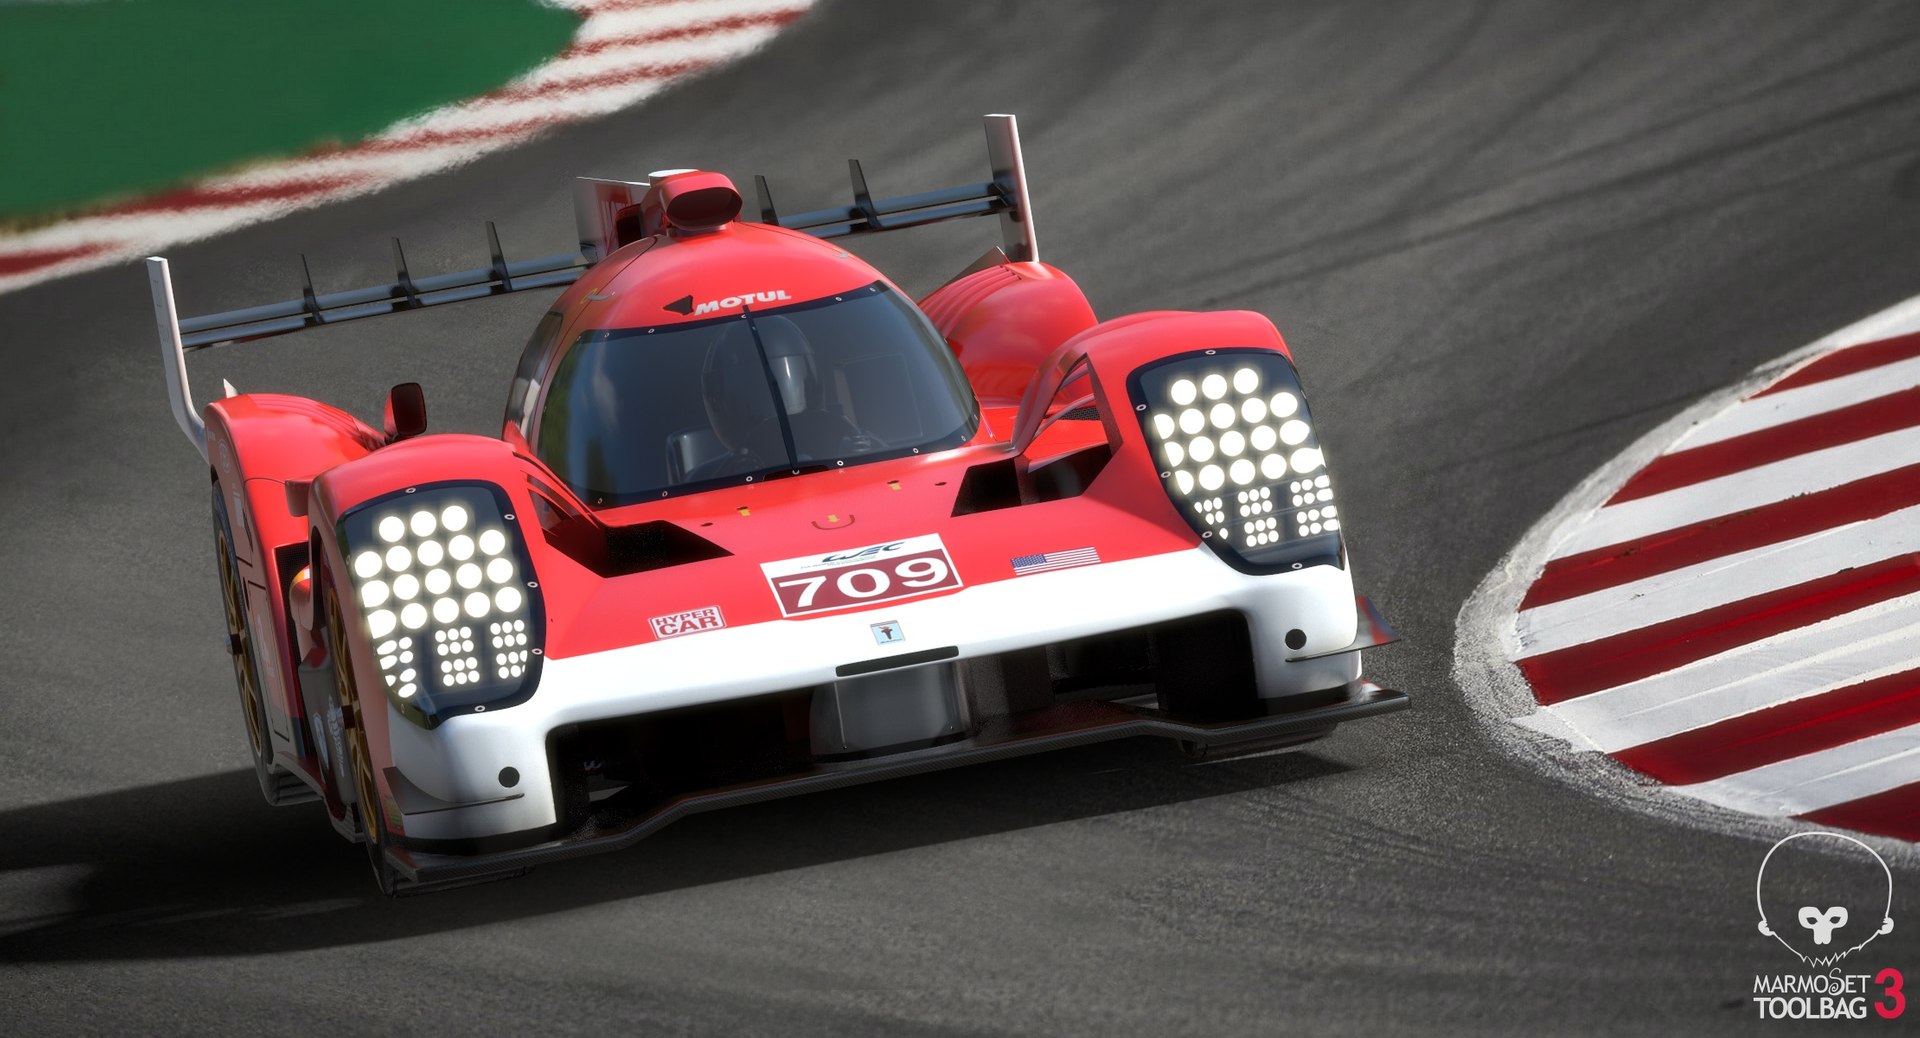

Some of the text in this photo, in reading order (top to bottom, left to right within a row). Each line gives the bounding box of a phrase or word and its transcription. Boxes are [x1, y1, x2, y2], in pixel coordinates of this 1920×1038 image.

[694, 290, 792, 316] MOTUL
[822, 541, 906, 563] WEC
[778, 557, 949, 608] 709
[655, 608, 715, 626] HYPER
[659, 616, 719, 635] CAR
